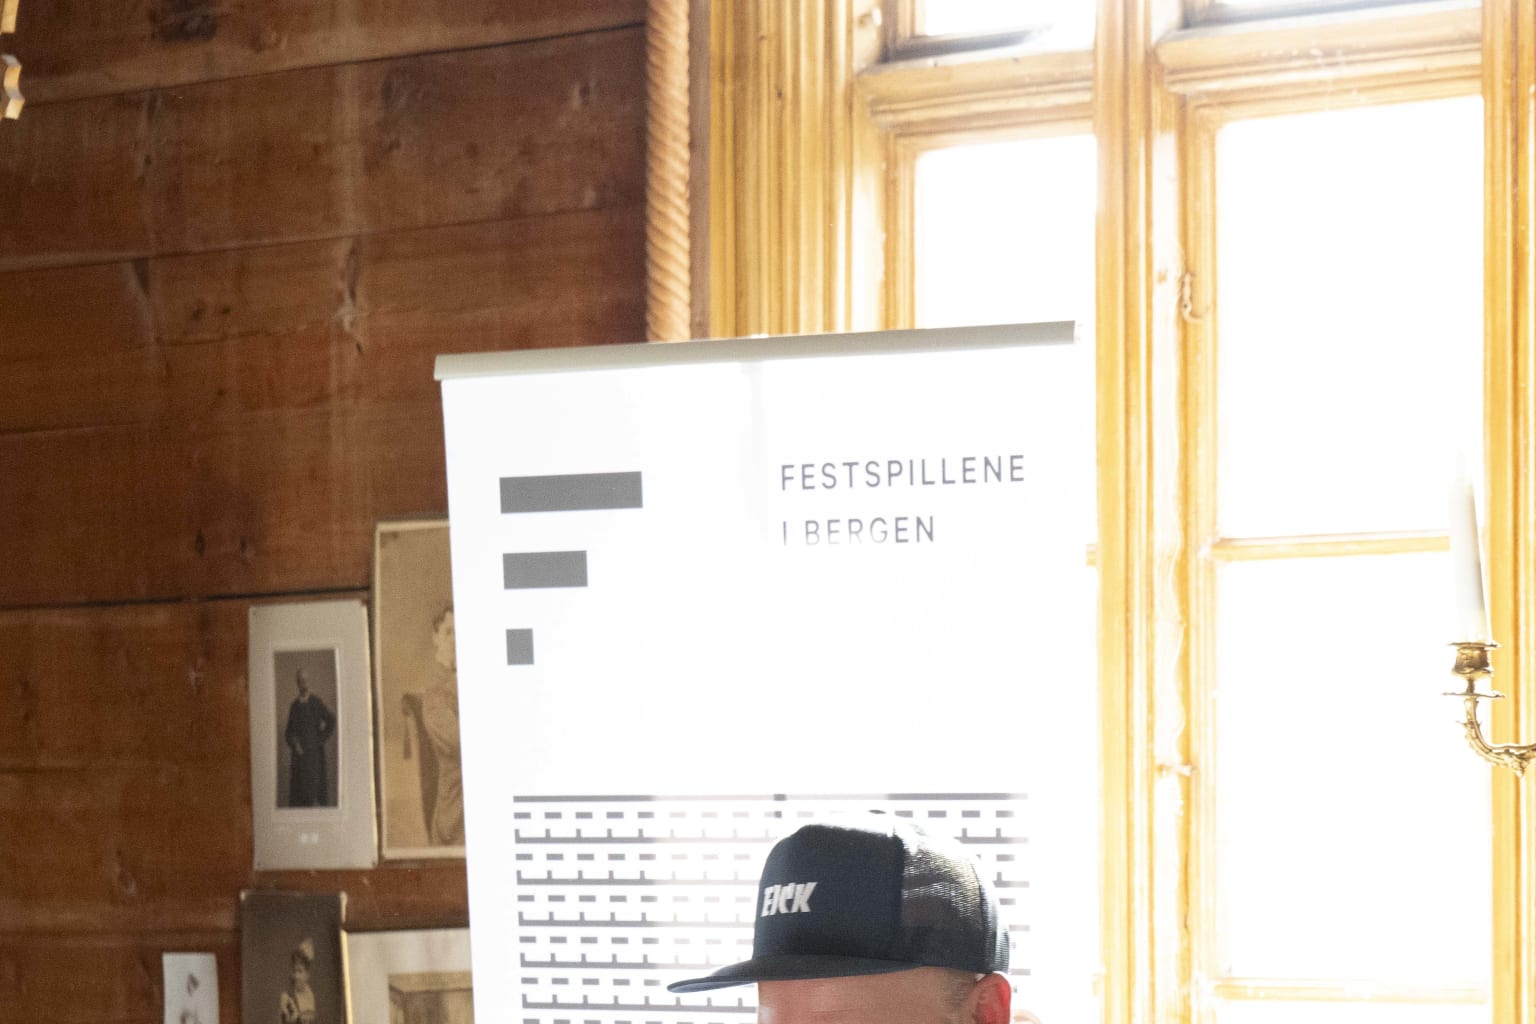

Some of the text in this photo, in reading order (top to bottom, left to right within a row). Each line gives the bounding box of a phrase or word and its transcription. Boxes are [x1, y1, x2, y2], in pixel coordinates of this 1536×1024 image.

[781, 454, 1025, 491] FESTSPILLENE
[781, 516, 935, 546] I BERGEN
